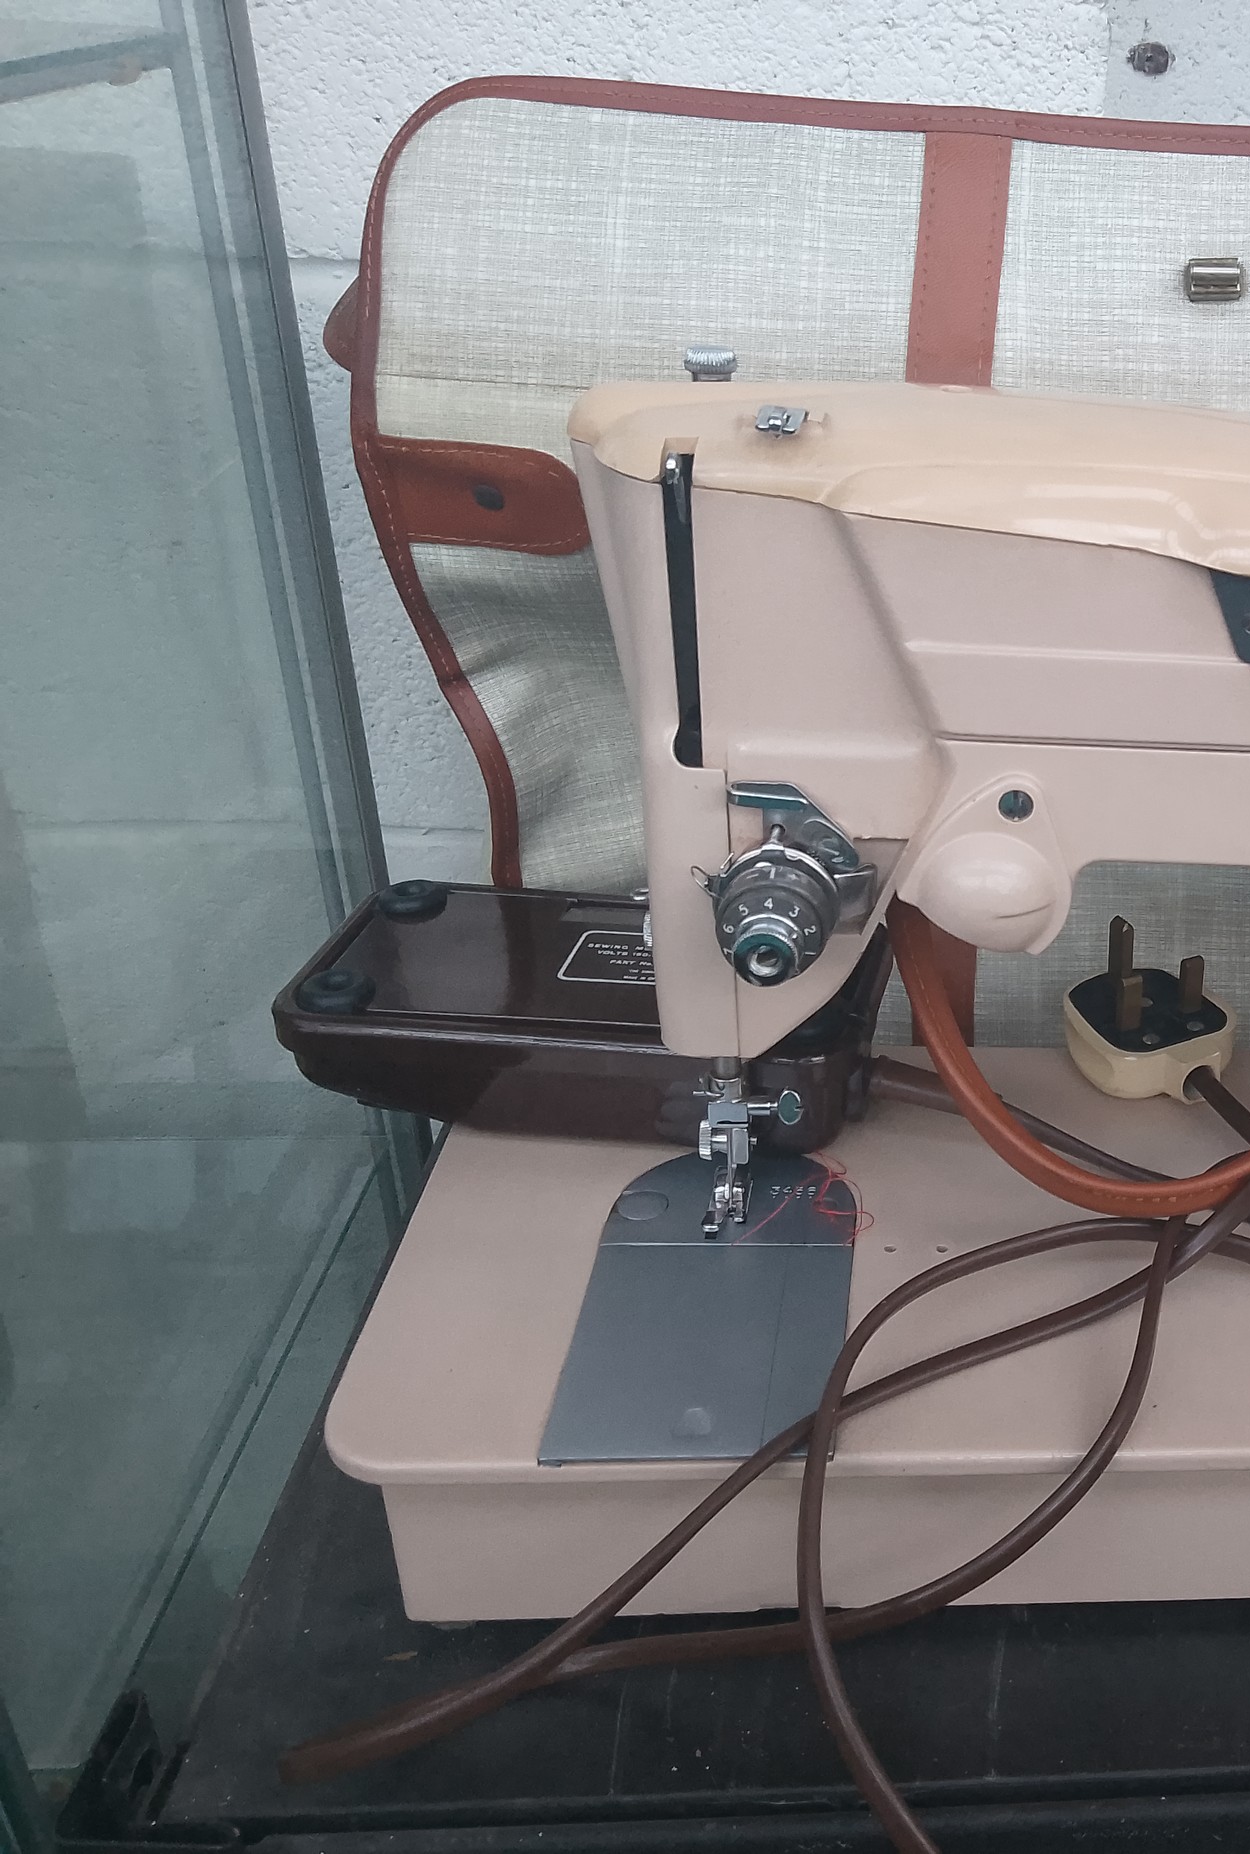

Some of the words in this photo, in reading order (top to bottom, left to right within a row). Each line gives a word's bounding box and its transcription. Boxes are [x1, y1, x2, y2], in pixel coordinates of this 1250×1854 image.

[738, 903, 749, 916] 5
[763, 897, 774, 910] 4
[788, 905, 800, 918] 3
[722, 924, 735, 934] 6
[804, 925, 817, 936] 2
